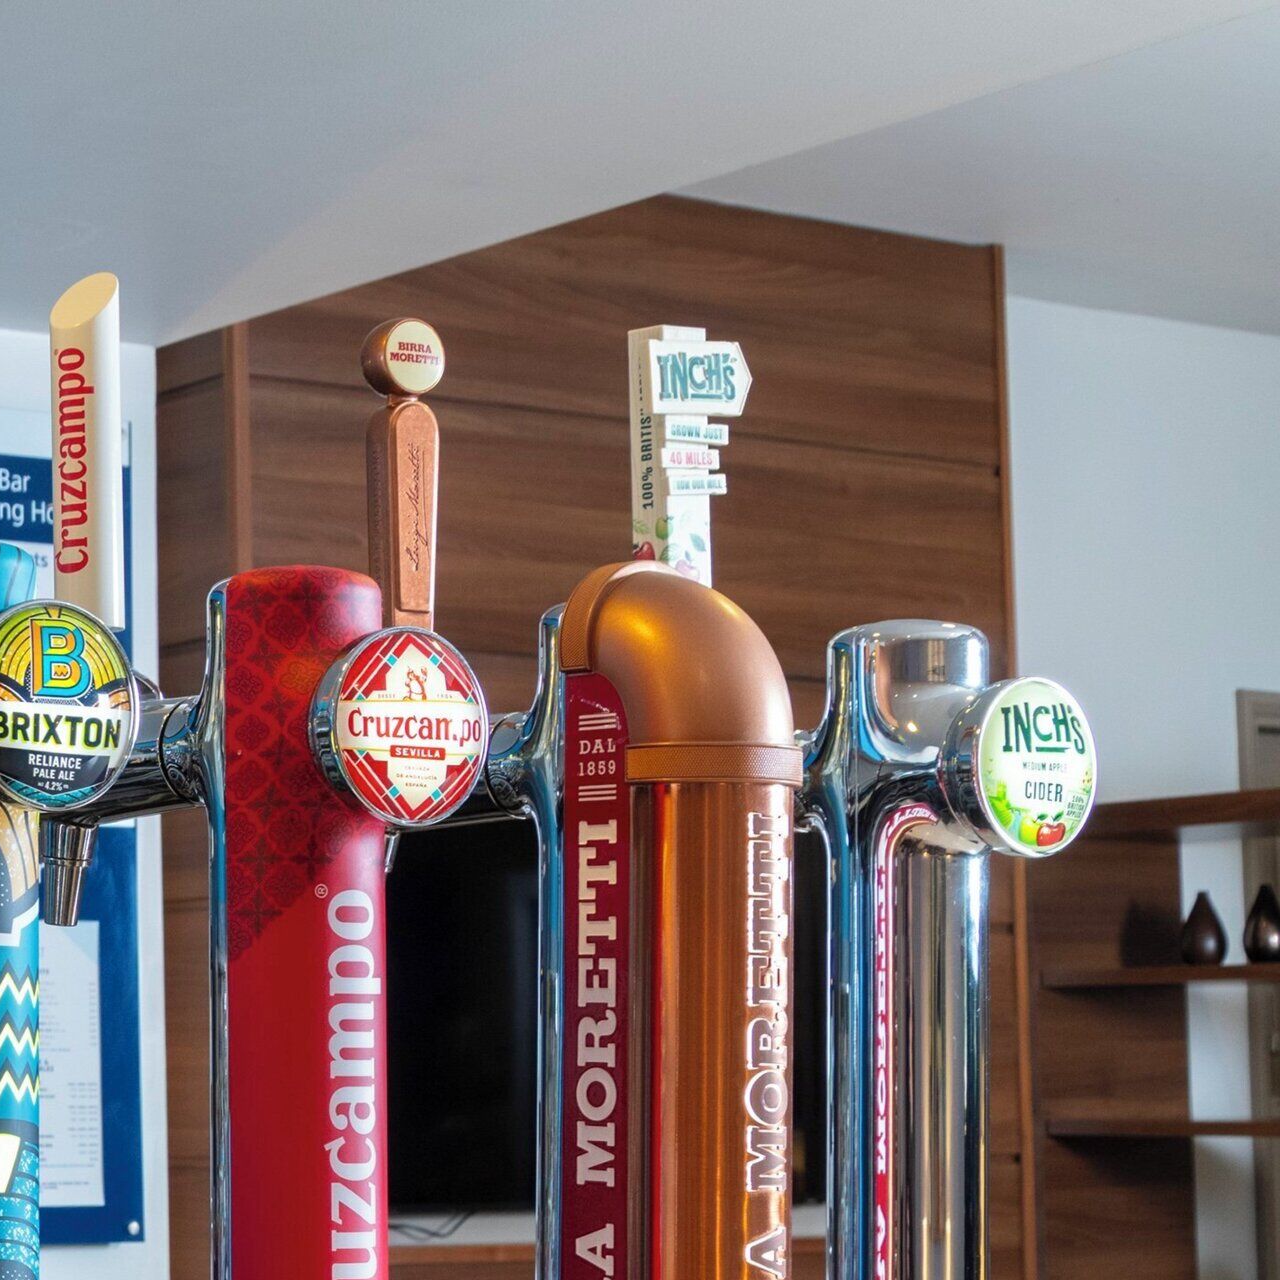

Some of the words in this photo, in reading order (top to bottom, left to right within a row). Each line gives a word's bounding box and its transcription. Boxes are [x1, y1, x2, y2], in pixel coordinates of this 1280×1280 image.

[398, 341, 432, 355] BIRRA
[389, 351, 439, 367] MORETTI
[656, 352, 737, 401] INCH'S
[640, 408, 652, 459] BRITIS
[671, 423, 700, 438] GROWN
[703, 425, 723, 441] JUST
[53, 347, 95, 575] Cruzcampo
[670, 452, 683, 465] 40
[685, 451, 713, 466] MILES
[642, 467, 654, 510] 100%
[30, 617, 93, 698] B
[1000, 702, 1086, 755] INCH'S
[395, 747, 441, 758] SEVILLA
[578, 738, 616, 755] DAL
[28, 753, 83, 770] RELIANCE
[577, 760, 616, 777] 1859
[1022, 761, 1047, 771] MEDIUM
[33, 767, 55, 780] PALE
[58, 770, 75, 781] ALE
[45, 781, 63, 791] 4.2%
[1024, 781, 1063, 803] CIDER
[575, 819, 618, 1188] MORETTI
[744, 811, 790, 1192] MORETTI
